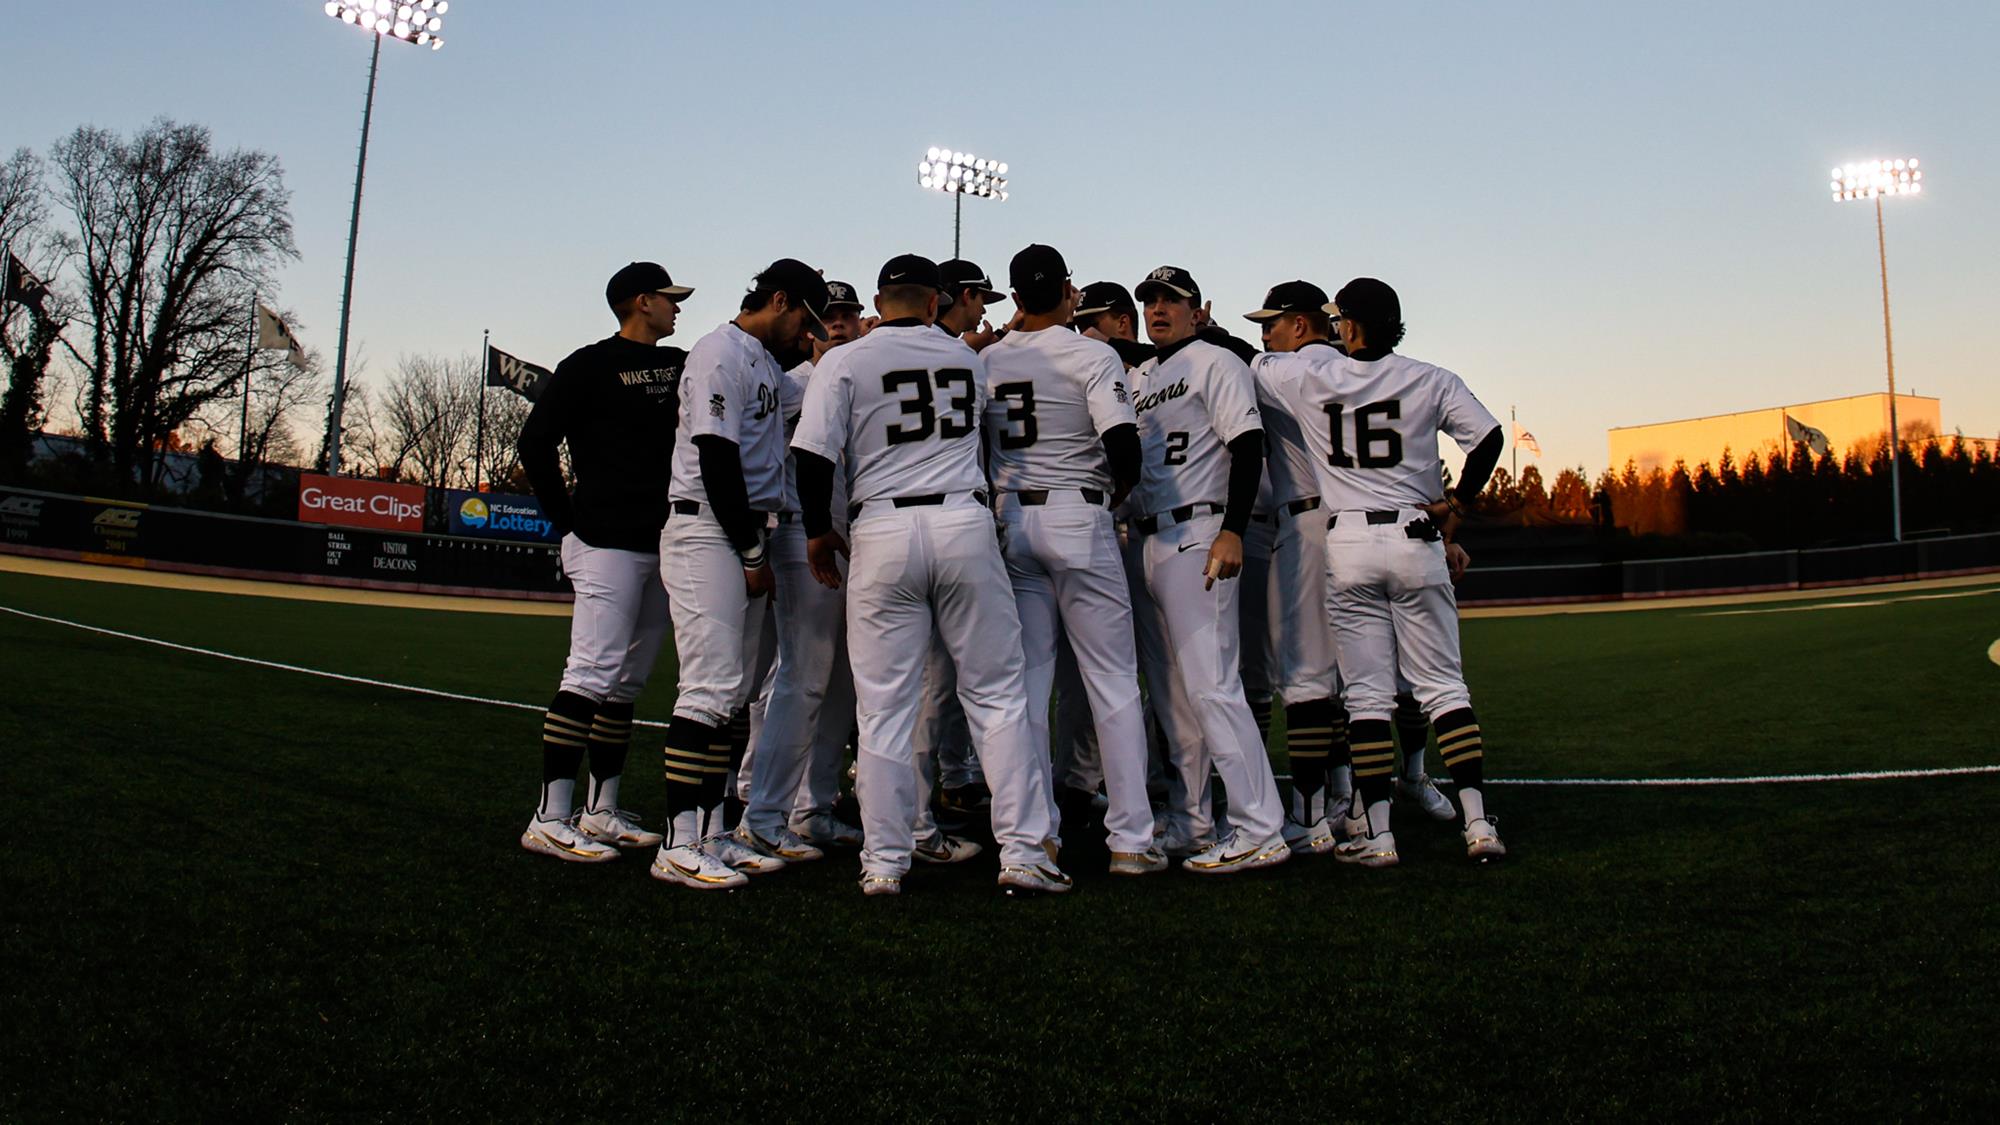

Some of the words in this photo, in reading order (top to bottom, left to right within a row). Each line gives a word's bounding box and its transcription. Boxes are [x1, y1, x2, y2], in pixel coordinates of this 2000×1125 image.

[498, 353, 539, 392] WF
[619, 370, 653, 385] WAKE
[882, 368, 976, 446] 33
[995, 381, 1038, 450] 3
[1323, 400, 1403, 469] 16
[1164, 431, 1189, 466] 2
[301, 487, 366, 513] Great
[370, 494, 422, 522] Clips
[490, 504, 502, 512] NC
[503, 504, 538, 514] Education
[490, 512, 552, 537] Lottery
[327, 541, 352, 551] STRIKE
[328, 532, 345, 541] BALL
[327, 550, 342, 558] OUT
[382, 541, 408, 555] VISITOR
[373, 556, 417, 571] DEACONS
